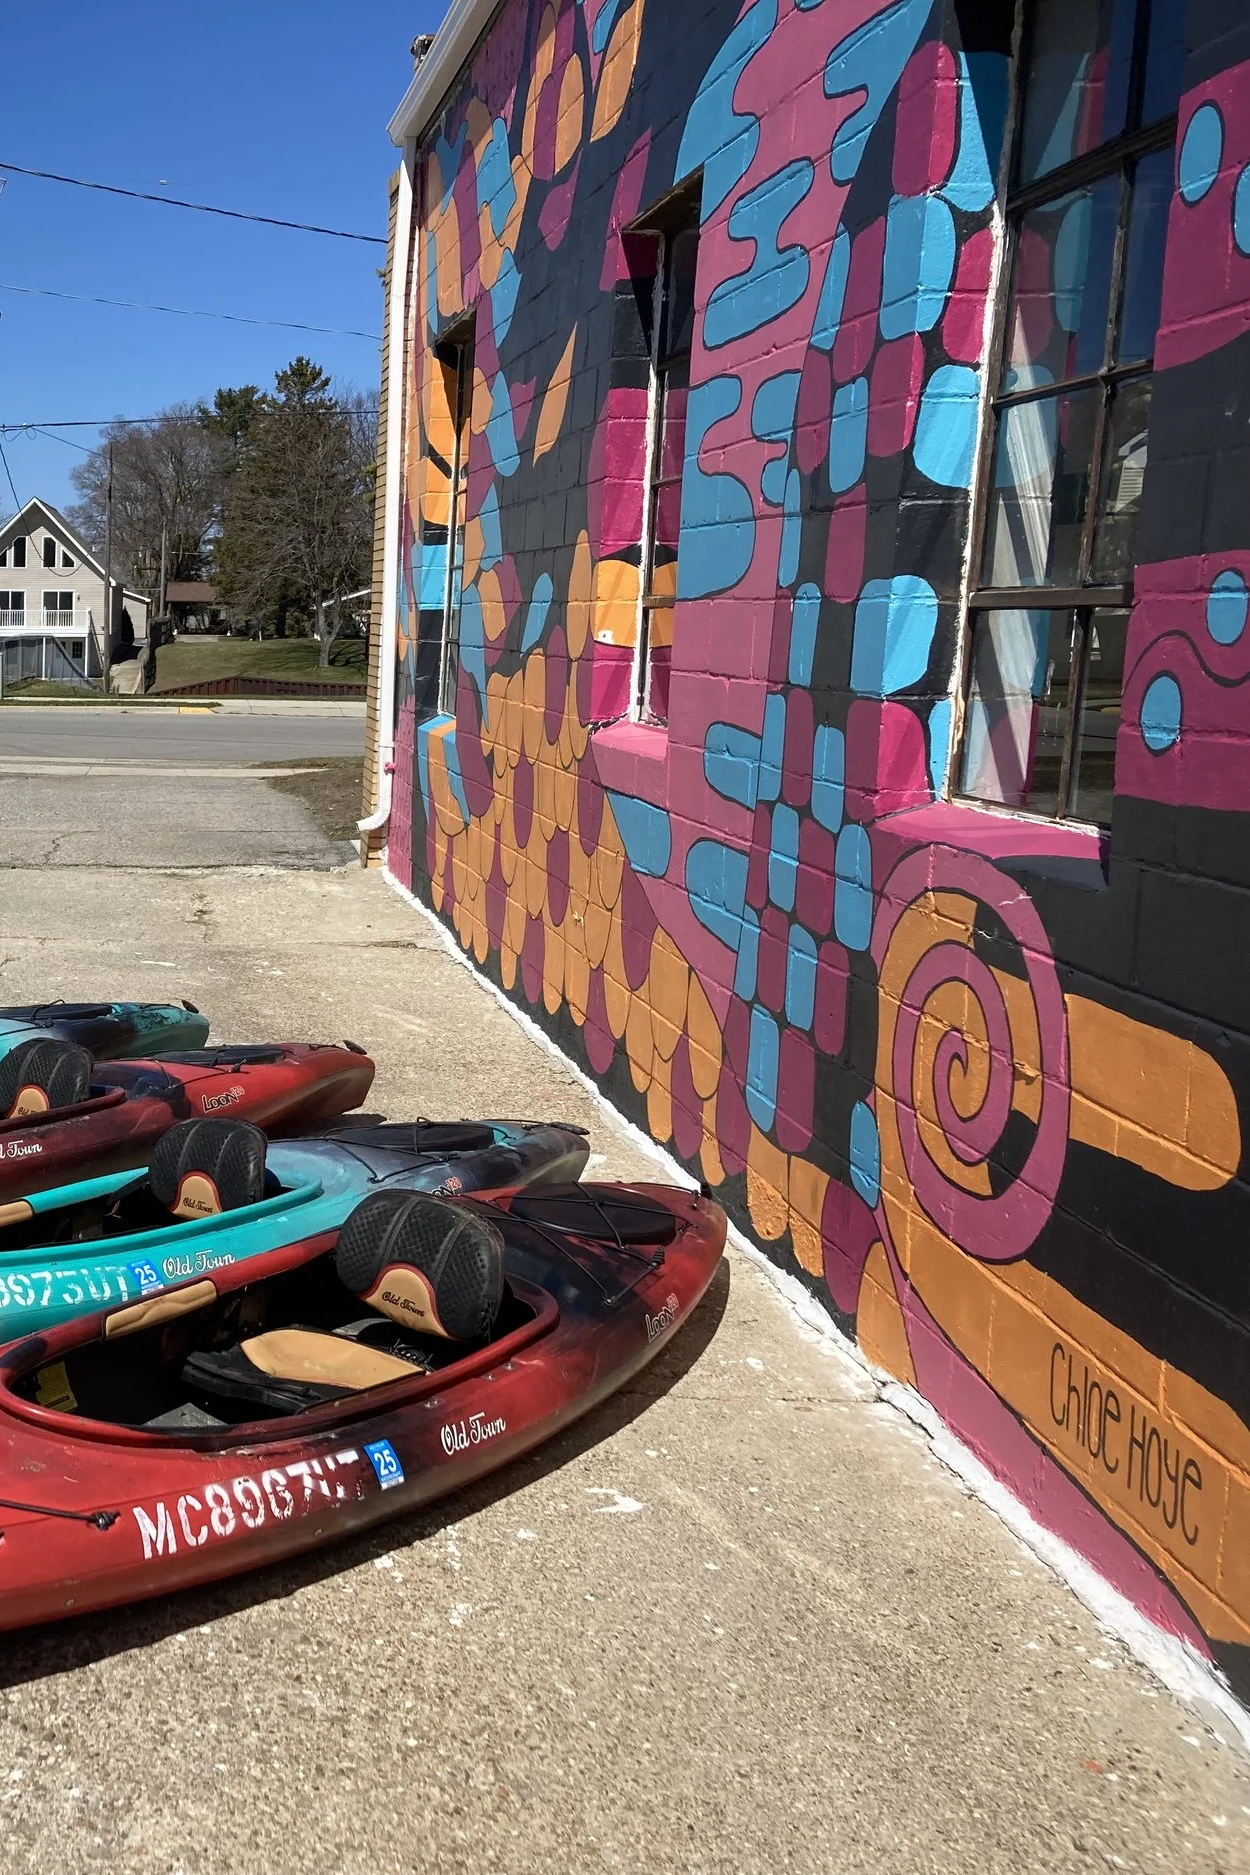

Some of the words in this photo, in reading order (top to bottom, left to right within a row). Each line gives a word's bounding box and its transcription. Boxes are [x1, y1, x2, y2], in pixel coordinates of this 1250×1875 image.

[6, 1139, 43, 1158] Town
[183, 1197, 196, 1208] Old
[134, 1264, 157, 1286] 25
[163, 1254, 193, 1279] Old
[194, 1249, 236, 1272] Town
[382, 1290, 401, 1306] Old
[400, 1298, 426, 1317] Town
[1050, 1342, 1121, 1474] Chloe
[440, 1419, 470, 1456] Old
[469, 1411, 506, 1444] Town
[373, 1448, 398, 1476] 25
